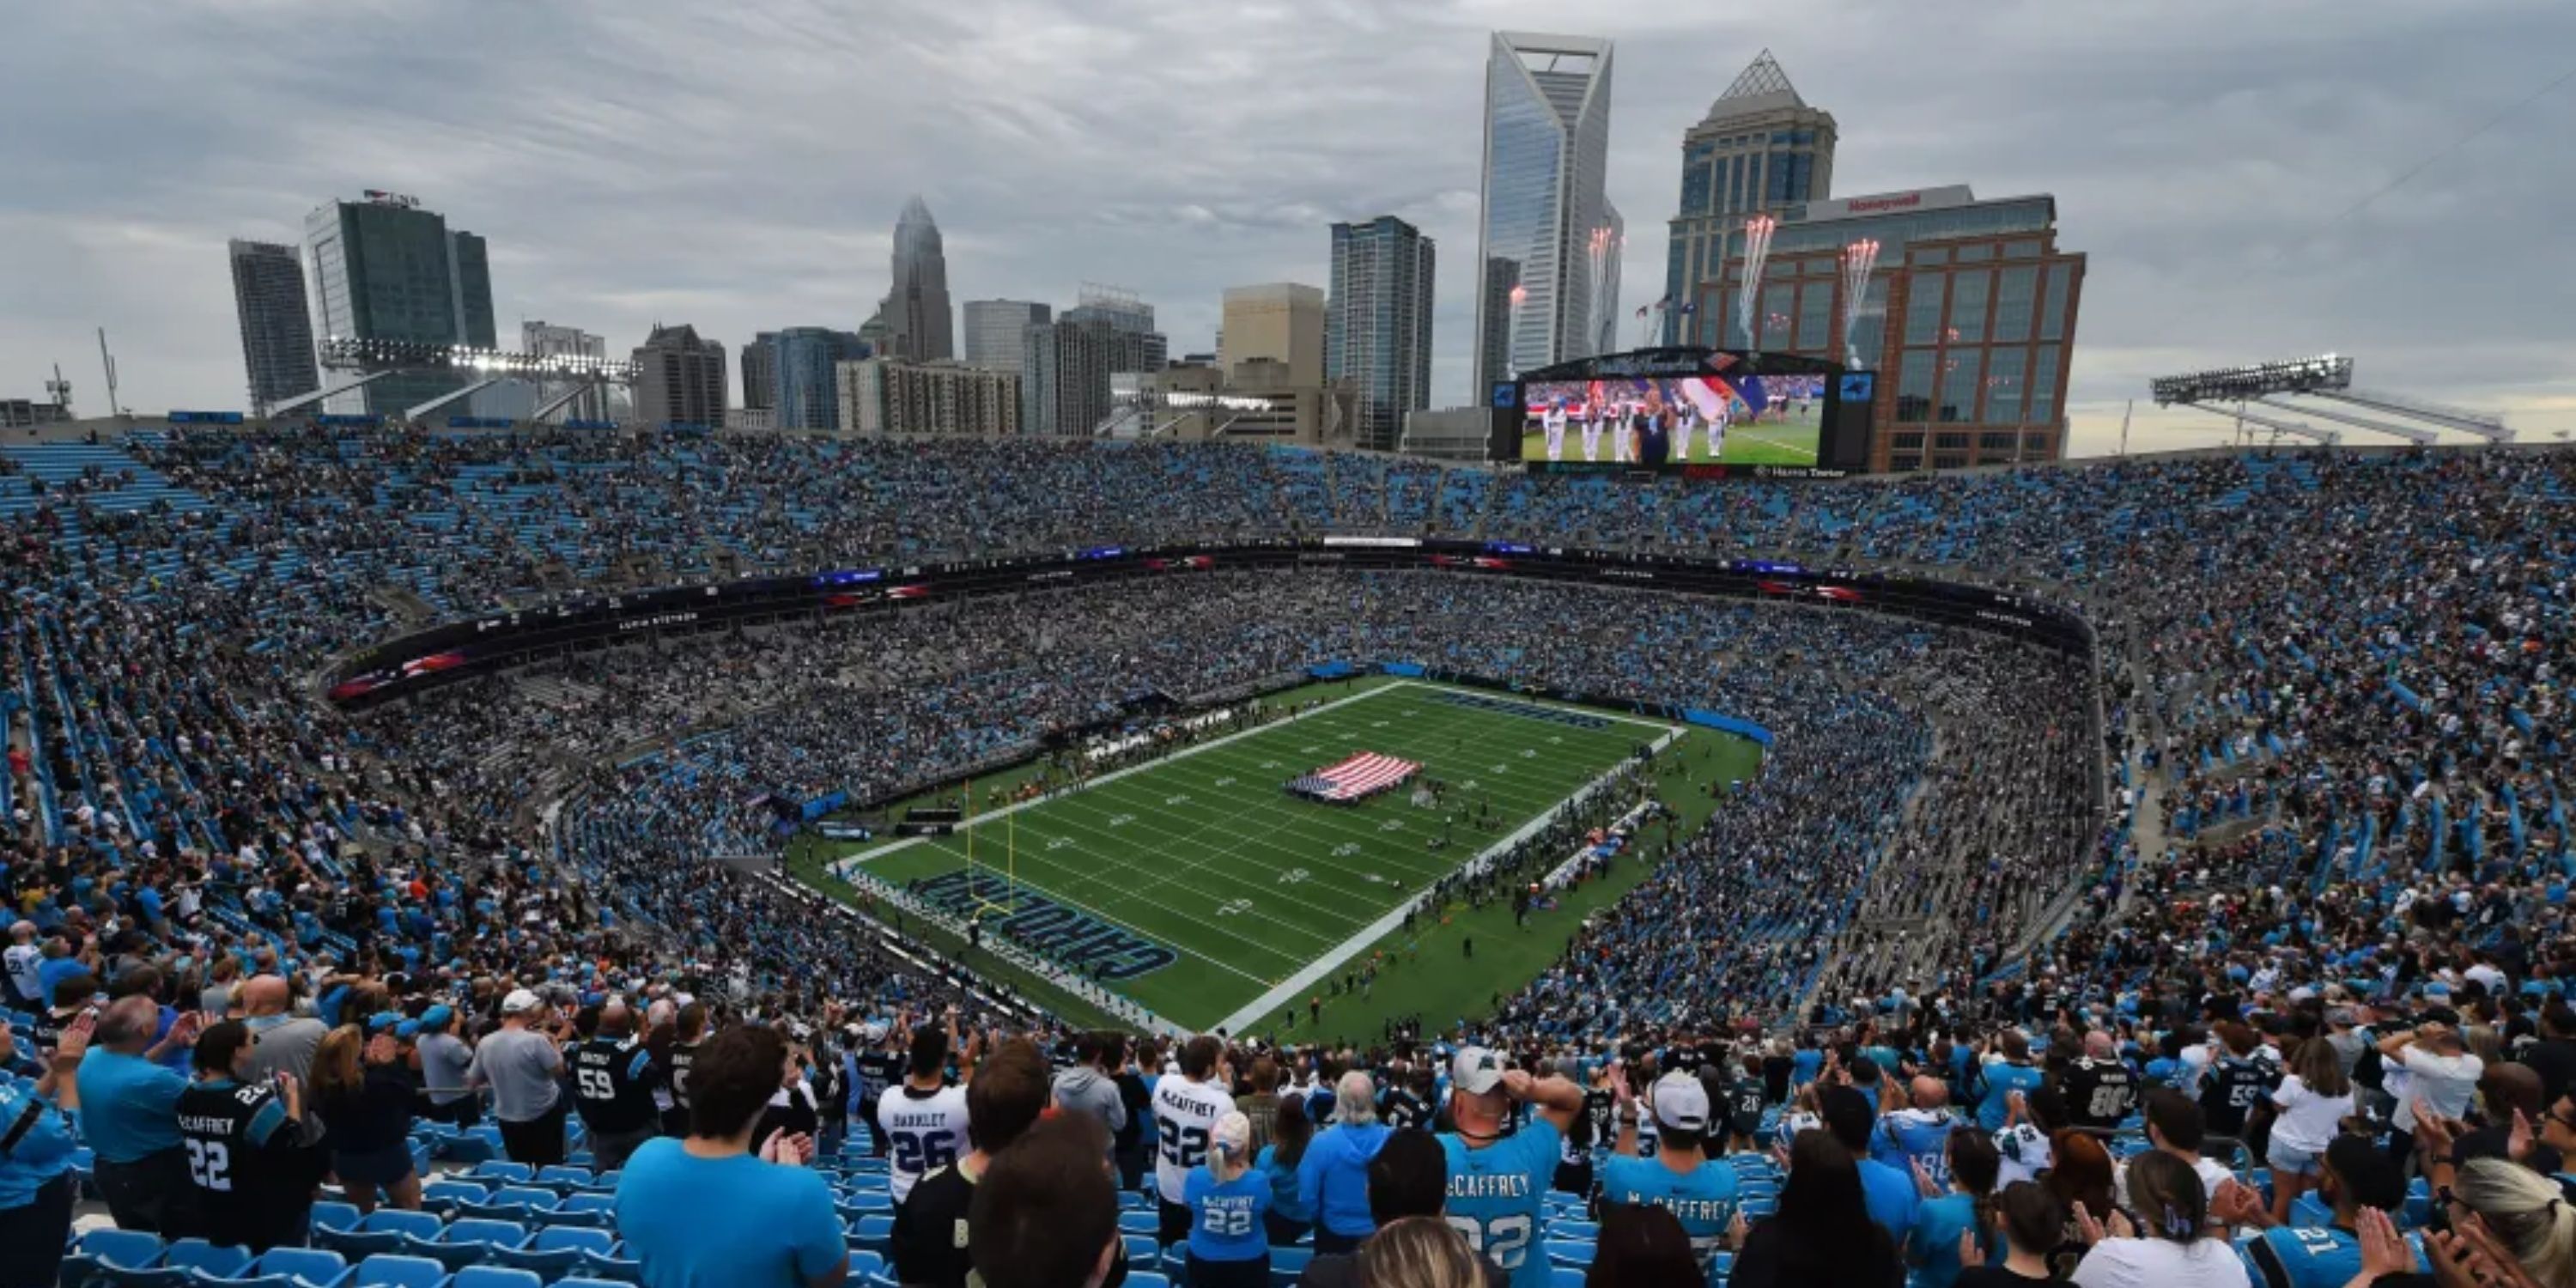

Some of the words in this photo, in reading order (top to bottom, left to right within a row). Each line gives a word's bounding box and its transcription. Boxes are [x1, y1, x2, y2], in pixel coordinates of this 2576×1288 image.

[908, 861, 1180, 981] CAROLINA
[578, 1069, 616, 1099] 59
[894, 1113, 946, 1127] BARKLEY
[892, 1130, 956, 1173] 26
[1158, 1114, 1209, 1168] 22
[185, 1137, 233, 1191] 22
[1445, 1172, 1531, 1198] cCAFFREY
[1628, 1190, 1730, 1220] MAFFREY
[1203, 1209, 1251, 1236] 22
